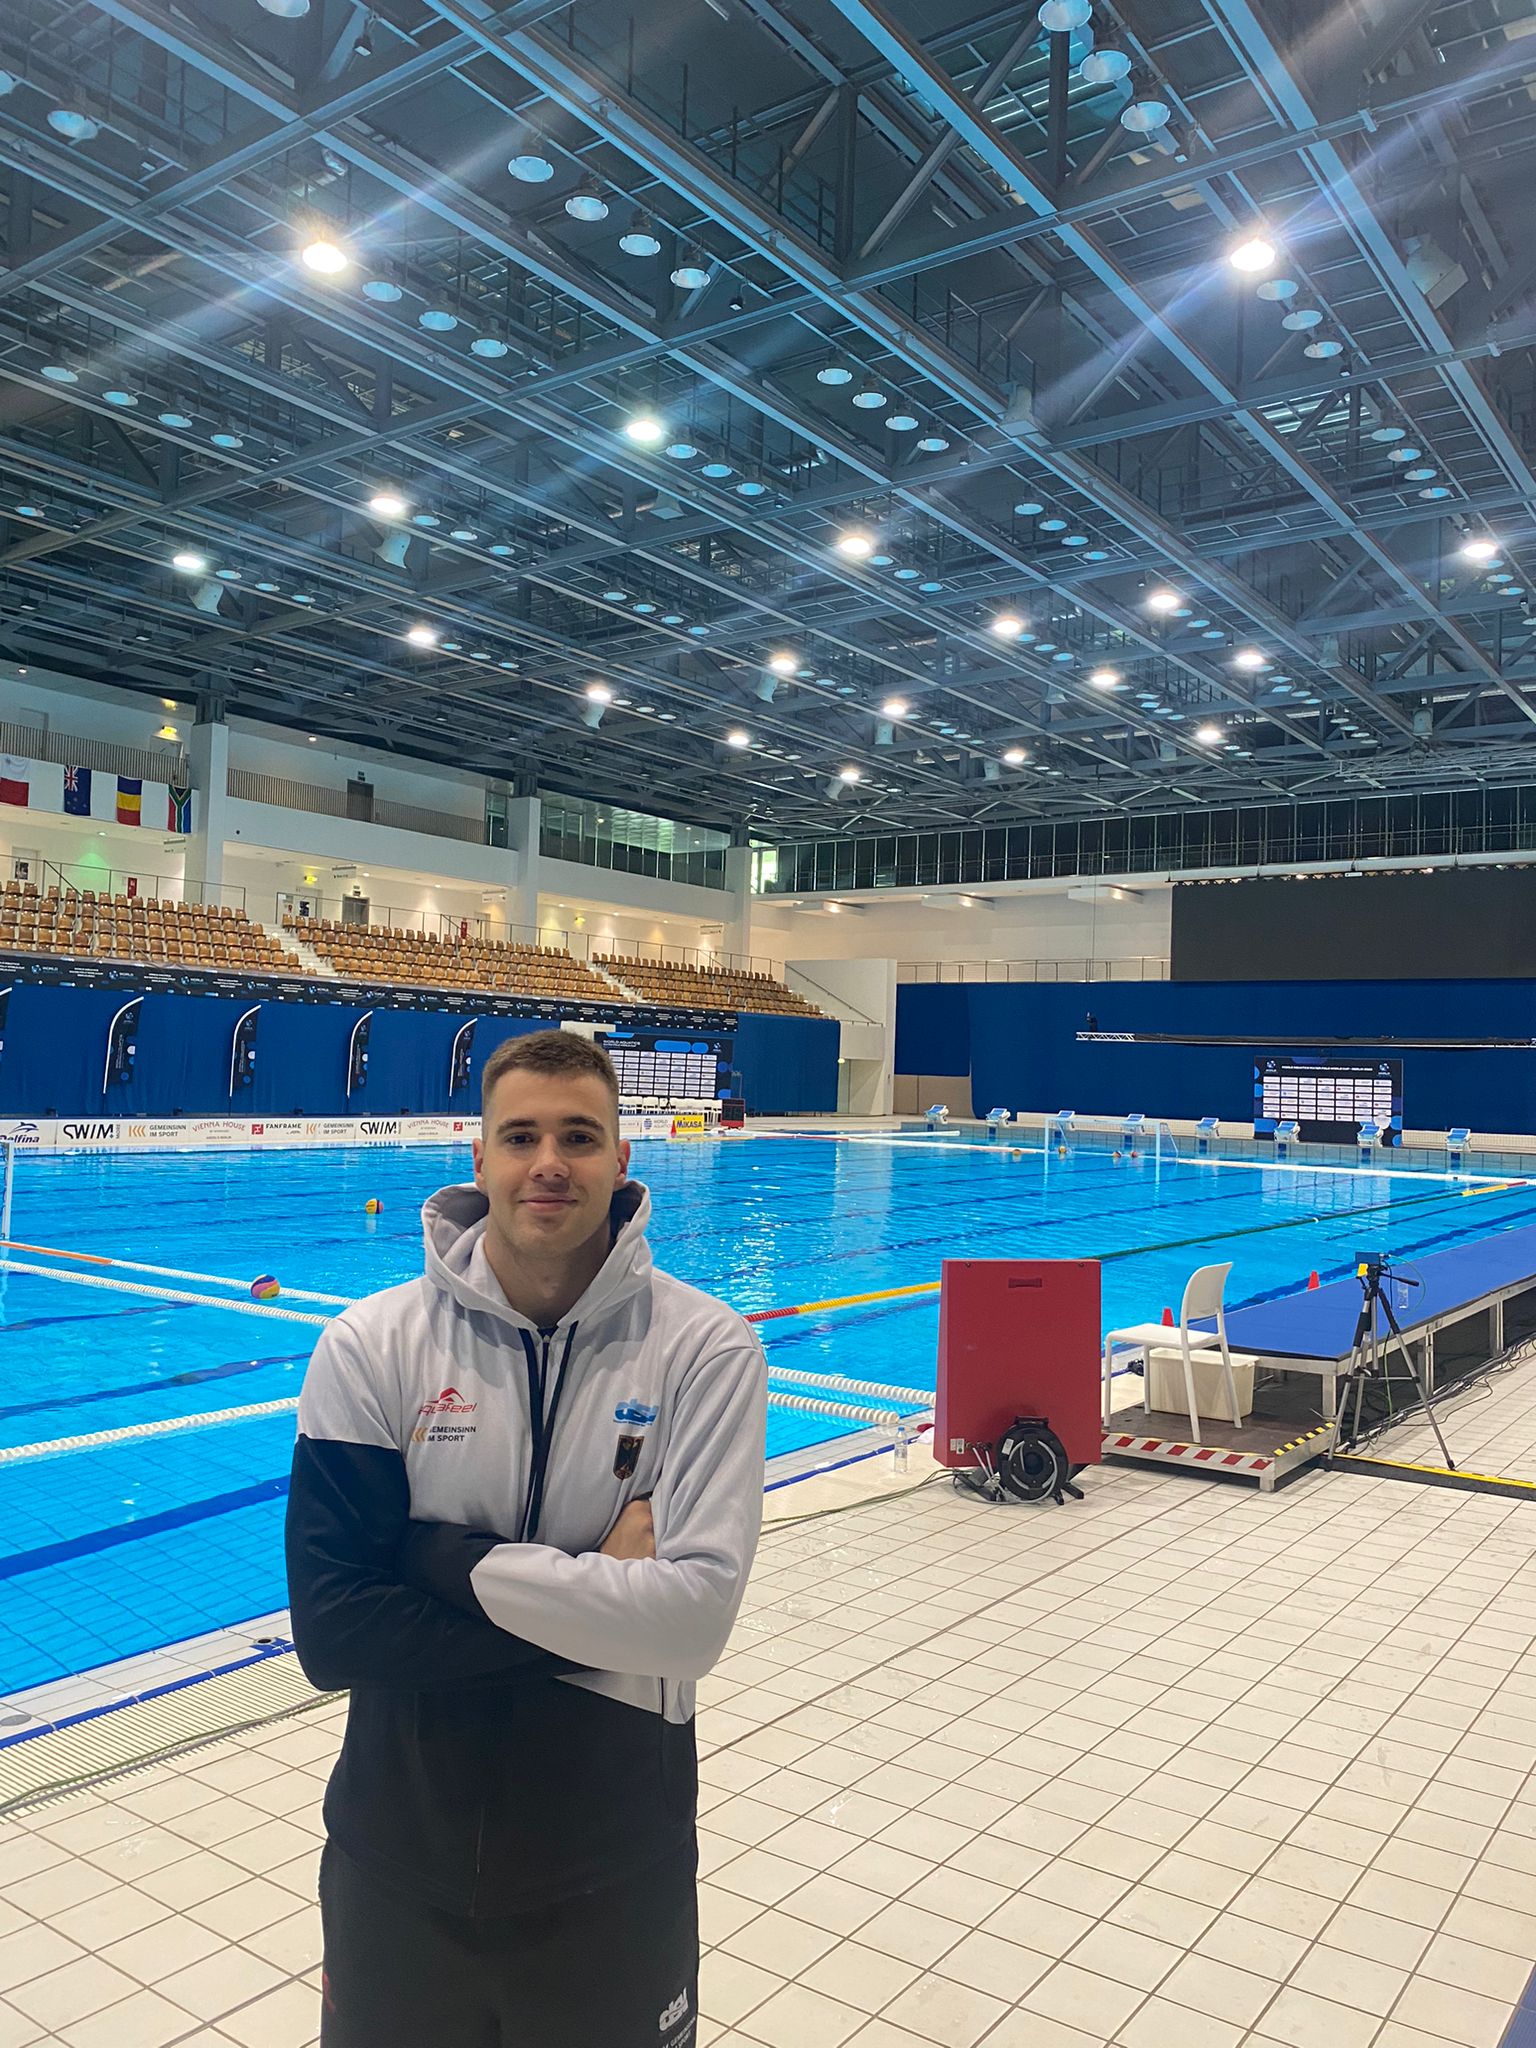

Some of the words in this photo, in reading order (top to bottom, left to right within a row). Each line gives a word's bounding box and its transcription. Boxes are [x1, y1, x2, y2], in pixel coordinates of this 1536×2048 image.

[63, 1124, 114, 1139] SWIM
[192, 1120, 220, 1132] VIENNA
[222, 1120, 246, 1131] HOUSE
[360, 1121, 397, 1135] SWIM
[430, 1425, 477, 1433] EMEINSINN
[437, 1434, 465, 1442] SPORT
